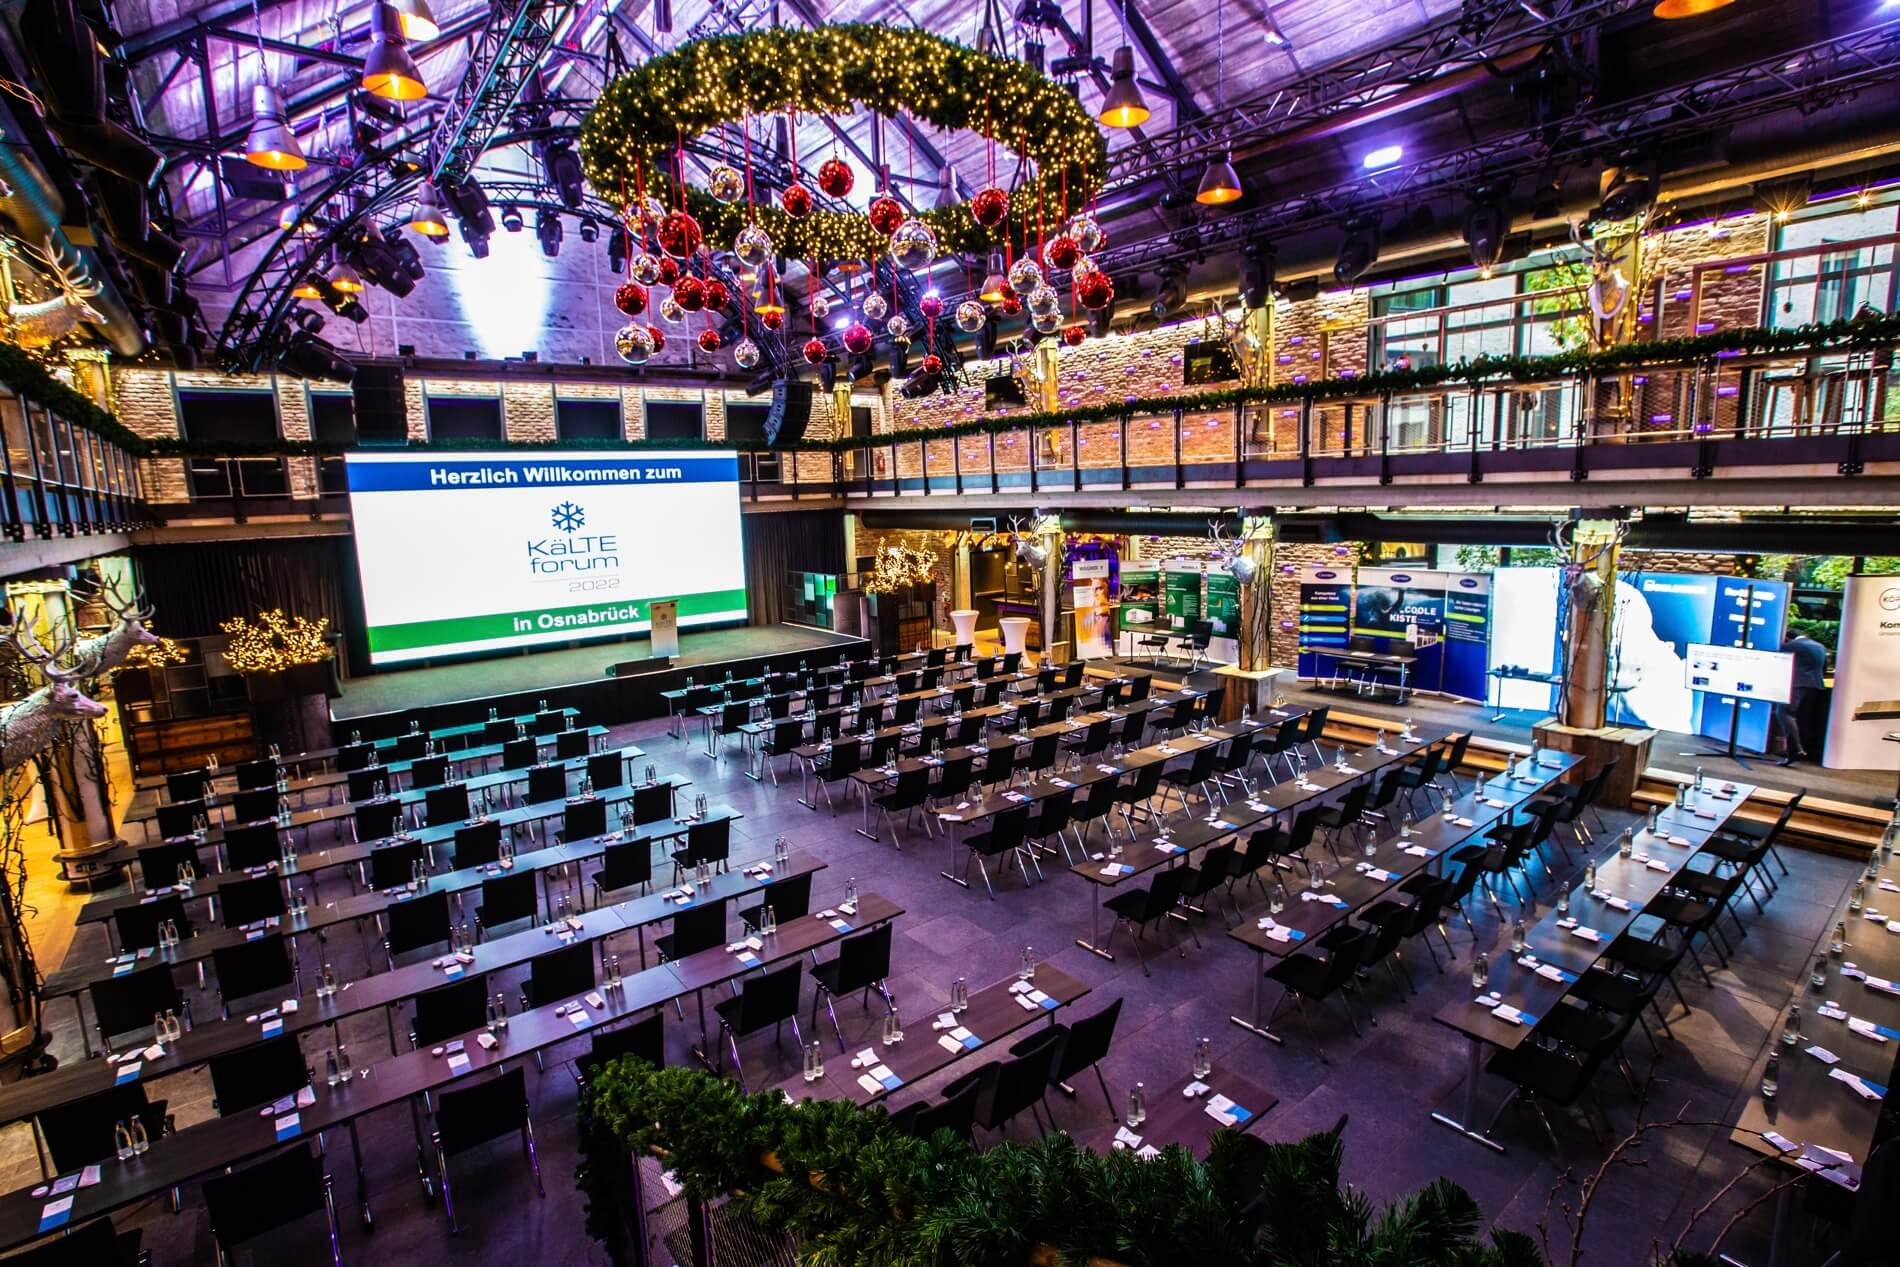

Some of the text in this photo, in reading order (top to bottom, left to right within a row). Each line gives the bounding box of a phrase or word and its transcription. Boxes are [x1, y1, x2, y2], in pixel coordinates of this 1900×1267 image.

[430, 466, 682, 485] Herzlich Willkommen zum
[528, 536, 618, 556] KäLTE
[530, 556, 619, 574] forum
[568, 578, 620, 592] 2022
[513, 605, 640, 632] in Osnabrück
[1389, 614, 1417, 623] KISTE
